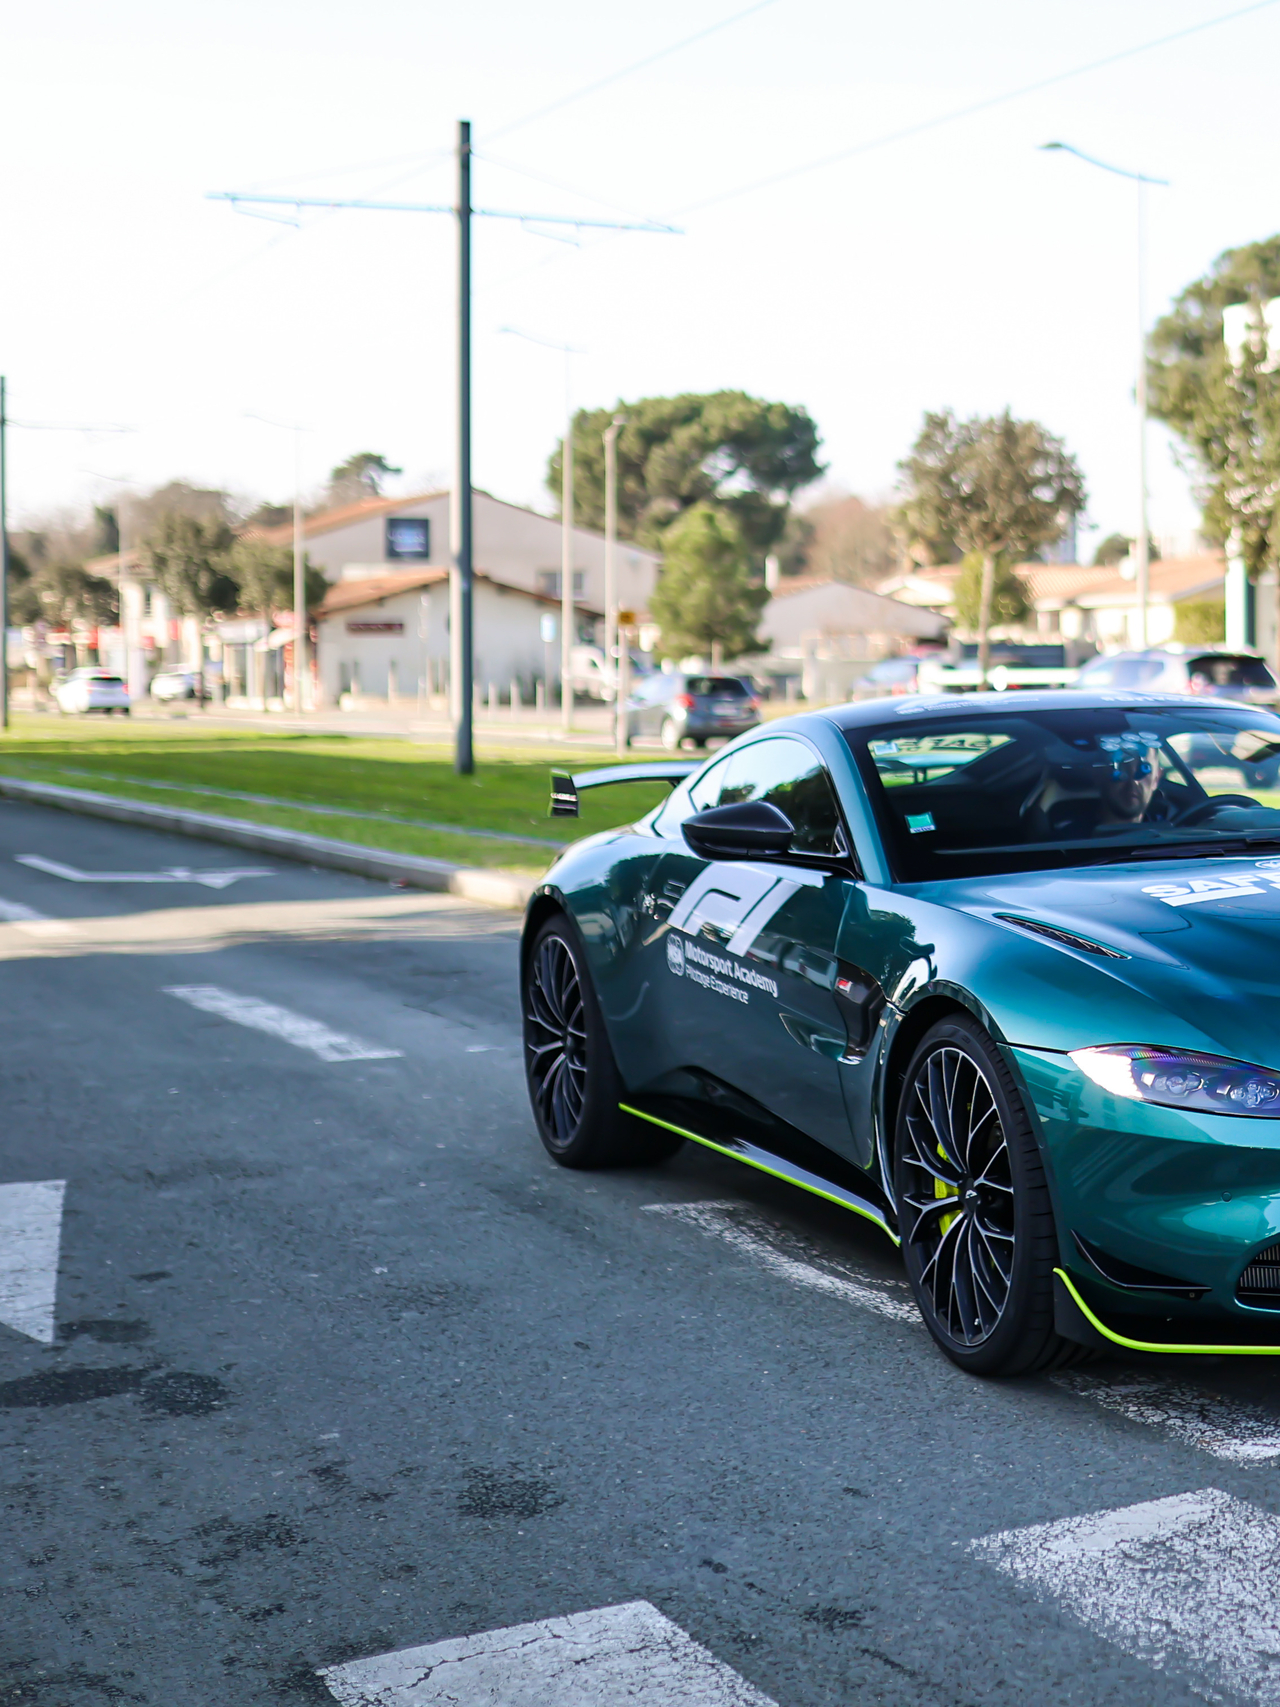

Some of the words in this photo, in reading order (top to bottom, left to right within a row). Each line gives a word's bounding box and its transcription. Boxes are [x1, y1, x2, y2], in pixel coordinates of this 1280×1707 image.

[685, 940, 733, 977] Motorsport
[734, 961, 778, 998] Academy
[685, 963, 710, 989] Pilotage
[710, 975, 749, 1005] Experience
